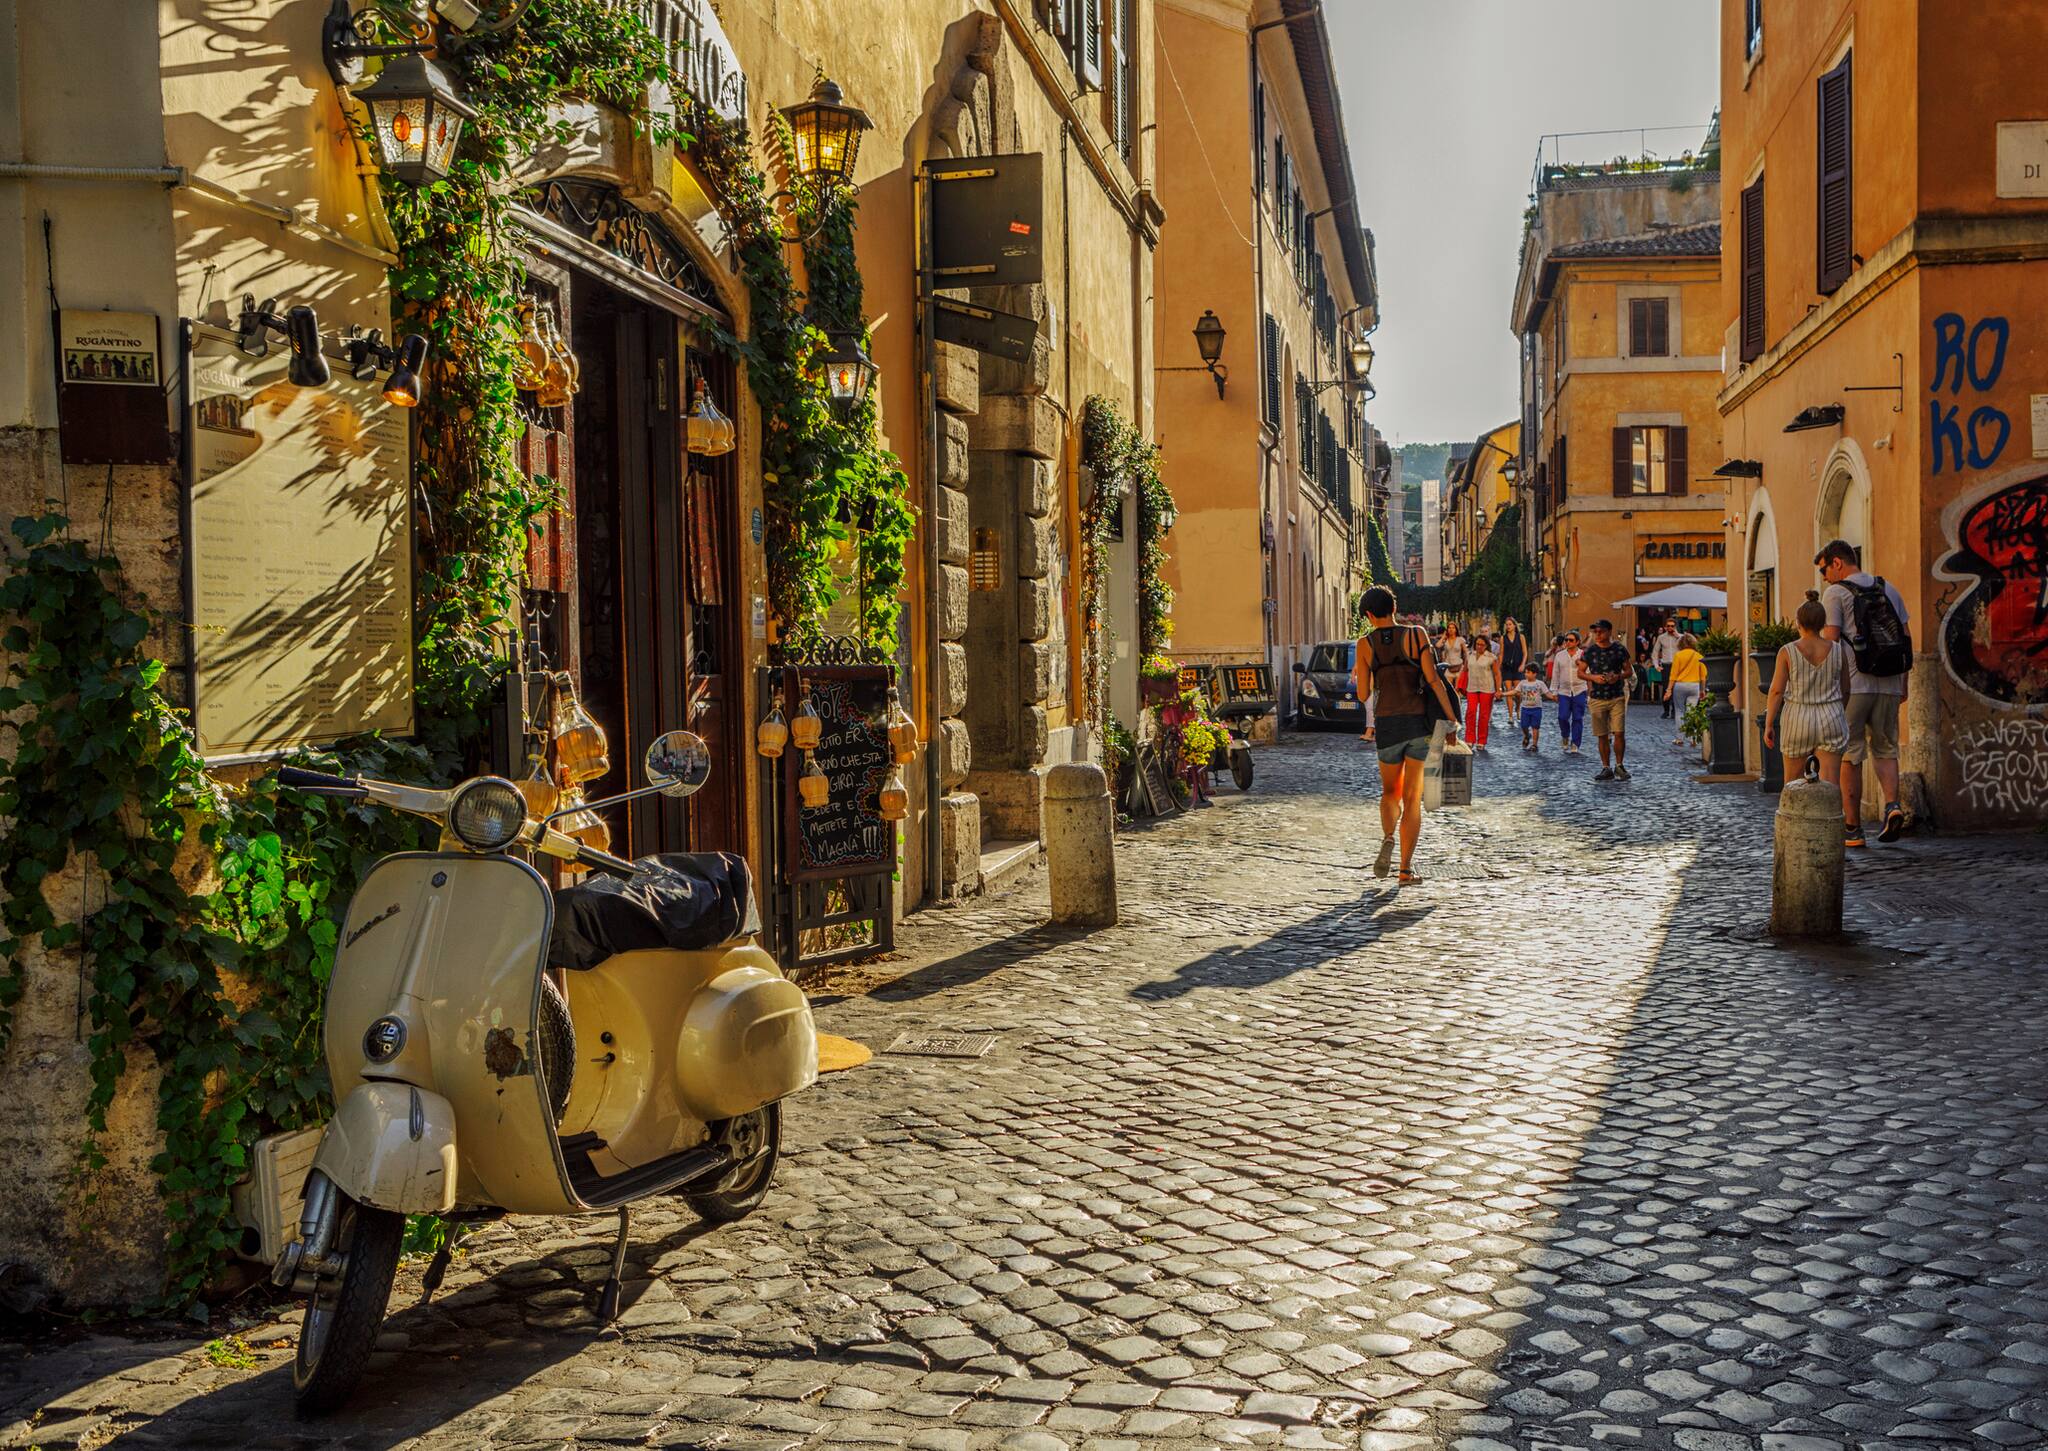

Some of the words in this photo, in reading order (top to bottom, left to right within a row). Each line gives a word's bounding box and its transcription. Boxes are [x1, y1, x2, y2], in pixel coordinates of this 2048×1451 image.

[2024, 164, 2041, 179] DI
[75, 336, 142, 348] RUGANTINO
[1930, 312, 2010, 395] RO
[1930, 399, 2011, 476] KO
[1645, 541, 1709, 559] CARLO
[818, 733, 842, 750] TUTTO
[845, 727, 864, 744] ER
[840, 754, 861, 768] CHE
[862, 752, 882, 765] STA
[810, 817, 848, 837] METTETE
[853, 815, 864, 829] A
